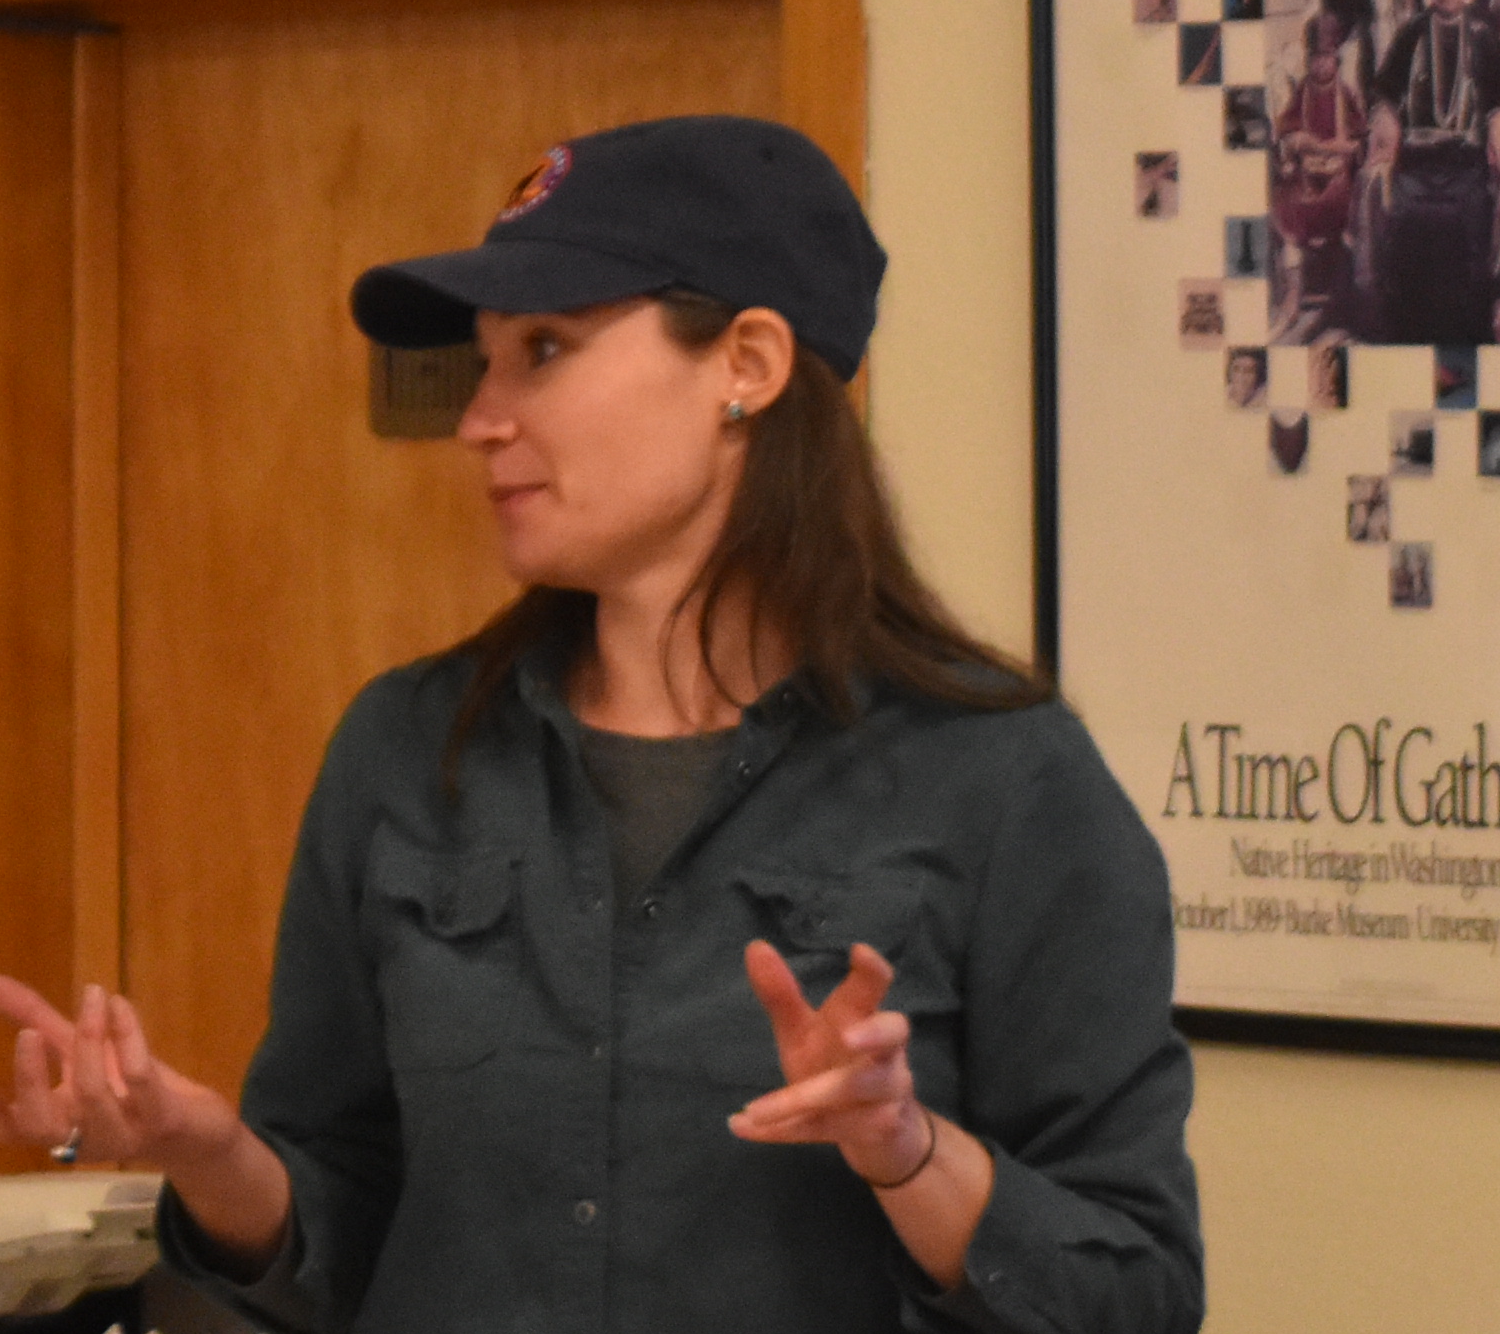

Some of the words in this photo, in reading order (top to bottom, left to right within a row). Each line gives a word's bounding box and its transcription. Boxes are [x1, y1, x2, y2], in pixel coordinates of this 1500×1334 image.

[1162, 720, 1203, 818] A
[1204, 724, 1320, 823] Time
[1328, 716, 1391, 825] Of
